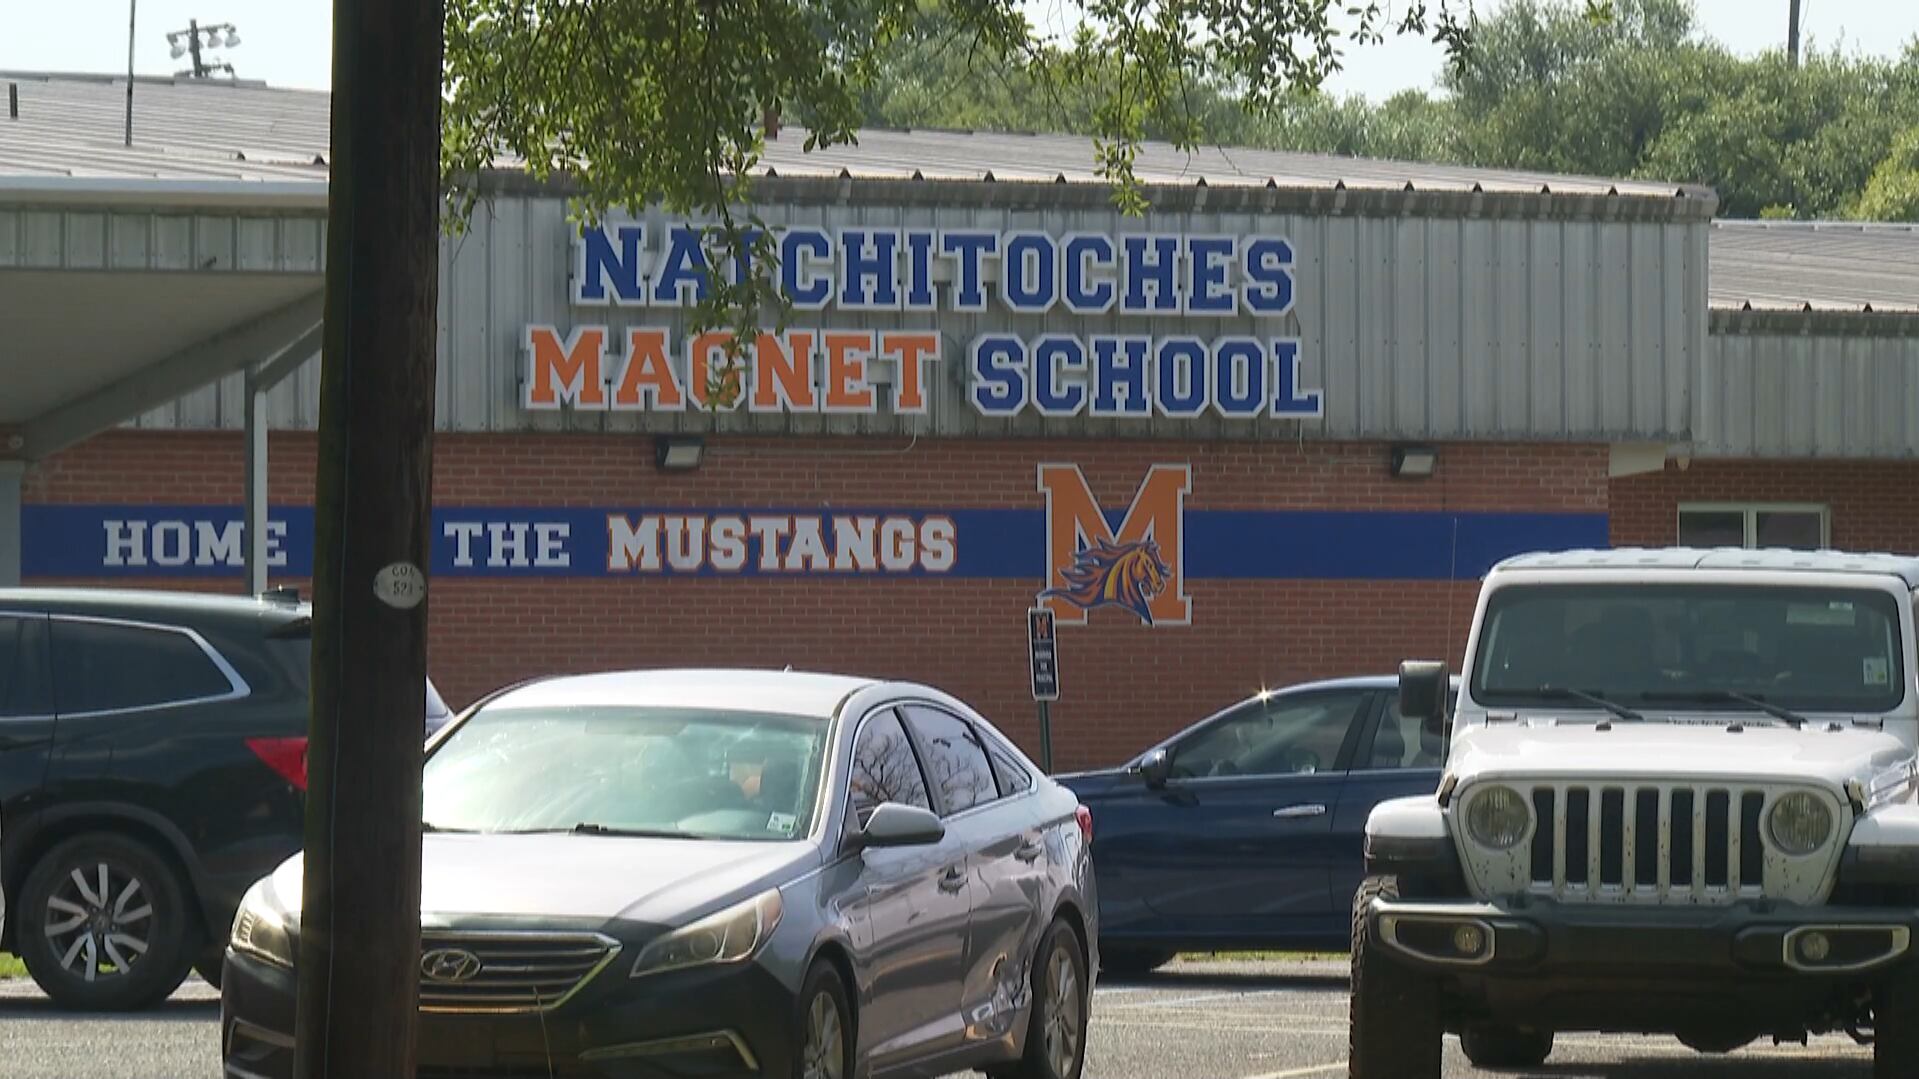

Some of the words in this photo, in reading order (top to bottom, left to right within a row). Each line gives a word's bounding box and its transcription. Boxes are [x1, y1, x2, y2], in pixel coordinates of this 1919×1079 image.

[571, 221, 1296, 317] NATCHITOCHES
[525, 323, 941, 414] MAGNET
[970, 332, 1323, 418] SCHOOL
[103, 520, 288, 567] HOME
[443, 522, 571, 568] THE
[606, 513, 956, 573] MUSTANGS
[1036, 463, 1193, 626] M
